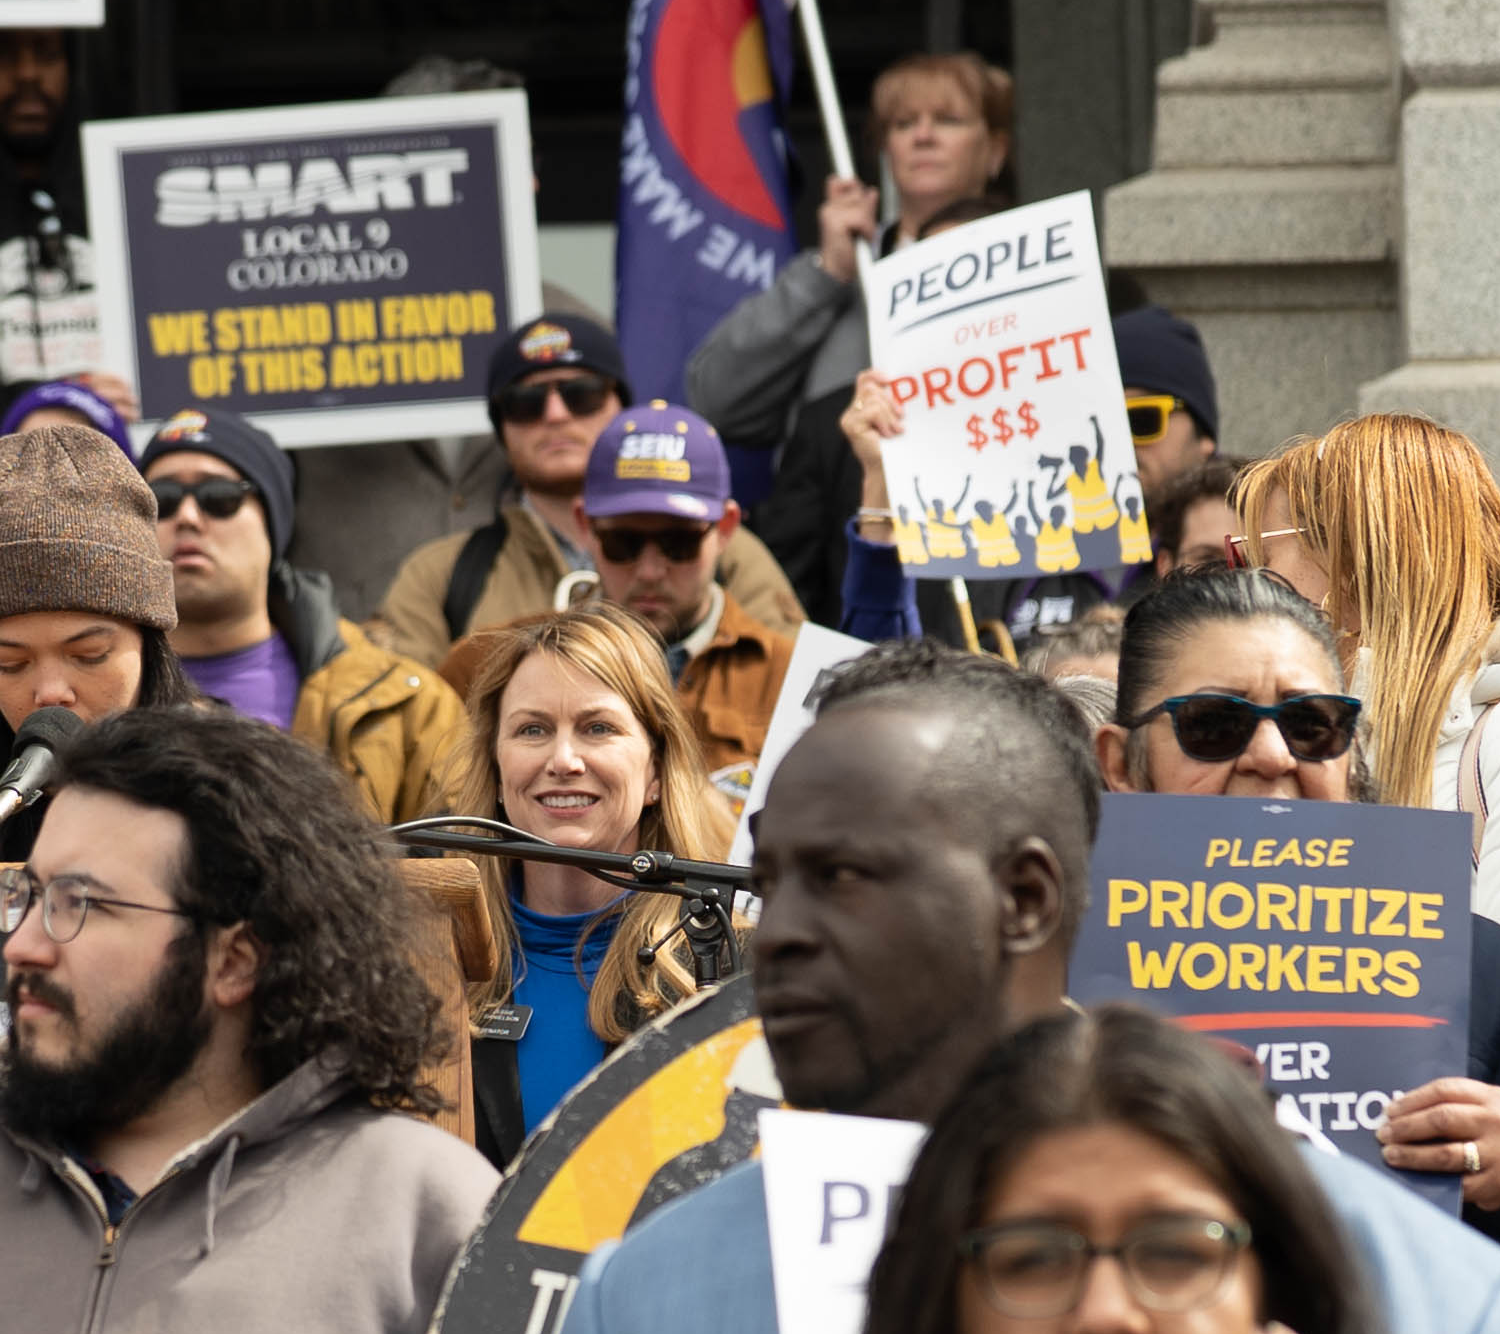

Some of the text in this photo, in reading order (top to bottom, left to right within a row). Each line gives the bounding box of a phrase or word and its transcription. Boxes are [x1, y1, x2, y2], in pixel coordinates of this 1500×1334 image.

[155, 148, 469, 227] SMART
[242, 217, 391, 258] LOCAL 9
[226, 248, 408, 291] COLORADO
[889, 221, 1075, 319] PEOPLE
[149, 312, 211, 357] WE
[213, 303, 332, 352] STAND
[335, 299, 378, 343] IN
[380, 290, 496, 340] FAVOR
[954, 313, 1019, 345] OVER
[189, 338, 464, 399] OF THIS ACTION
[890, 328, 1094, 410] PROFIT
[966, 400, 1041, 451] $$$
[1206, 837, 1354, 869] PLEASE
[1105, 881, 1446, 940] PRIORITIZE
[1126, 942, 1422, 999] WORKERS
